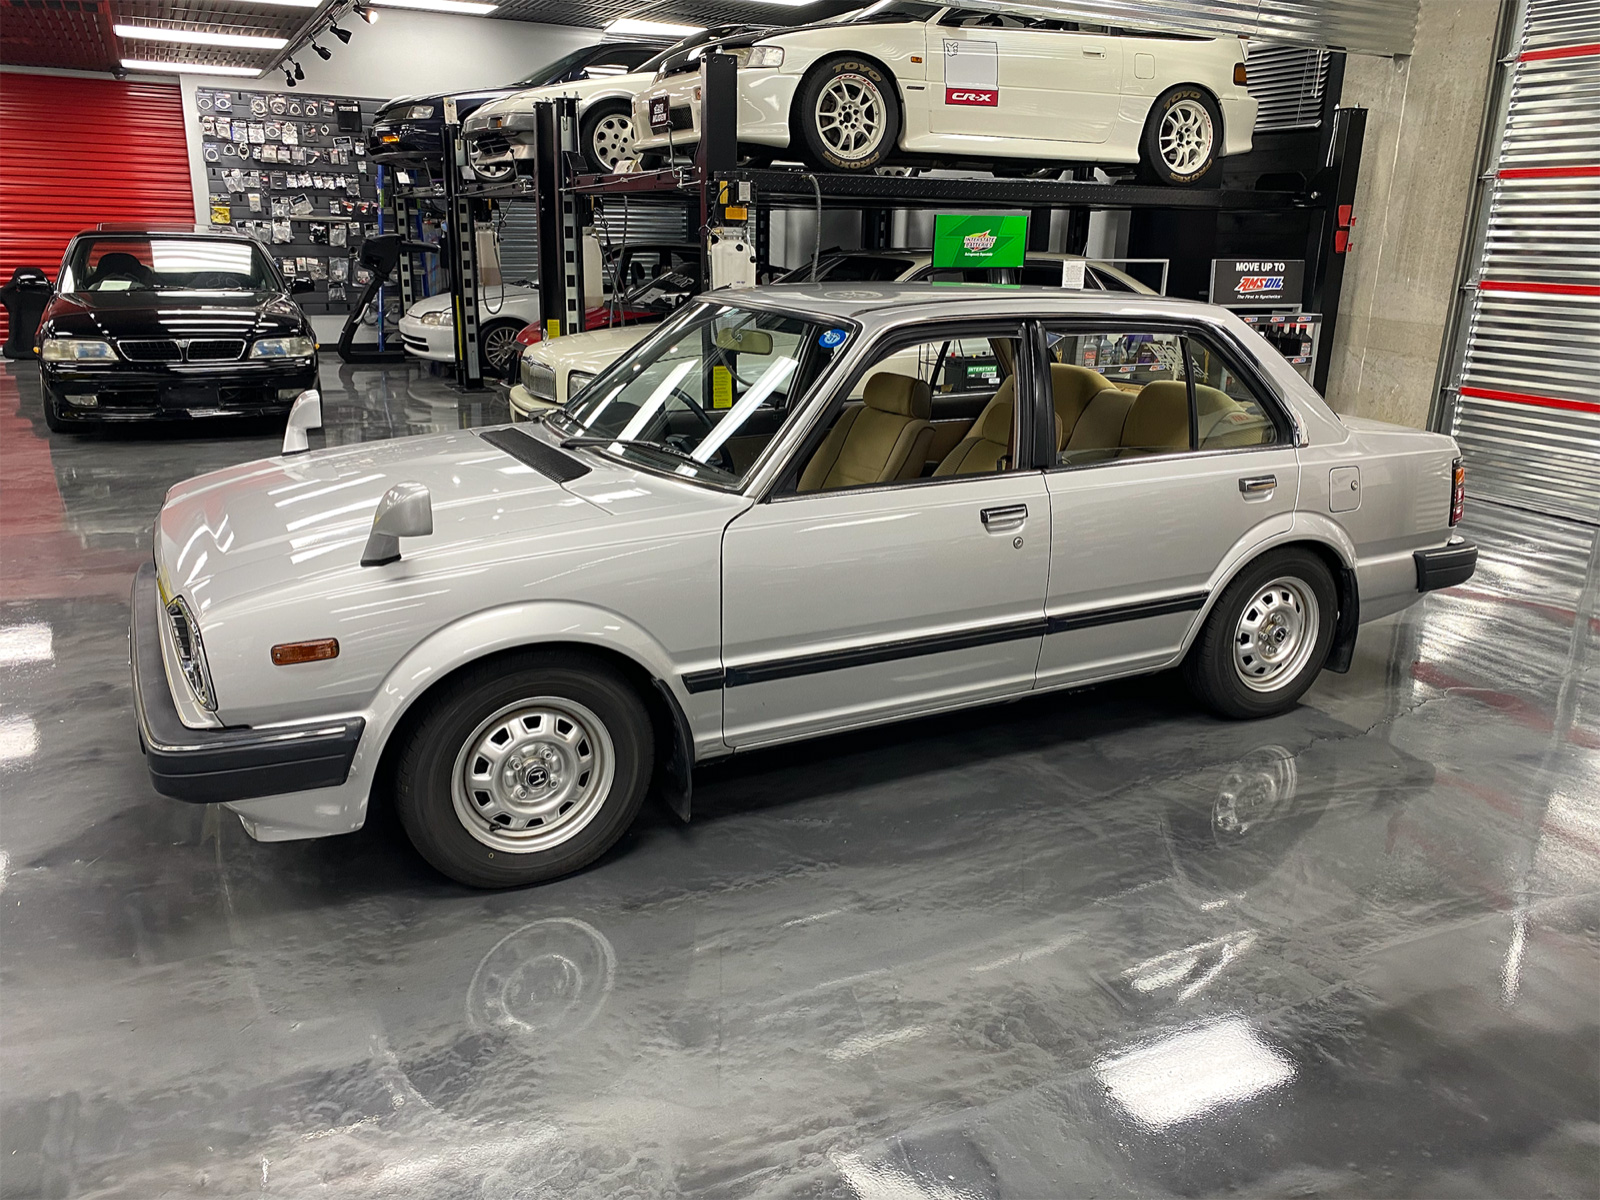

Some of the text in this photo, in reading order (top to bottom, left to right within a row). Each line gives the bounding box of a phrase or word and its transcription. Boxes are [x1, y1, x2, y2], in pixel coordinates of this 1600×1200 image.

[833, 62, 881, 82] TOYO
[951, 92, 992, 102] CR-X
[1163, 90, 1202, 110] TOYO
[822, 150, 881, 169] PROXES
[1235, 262, 1286, 272] MOVE UP TO
[1236, 277, 1283, 292] AMSOIL
